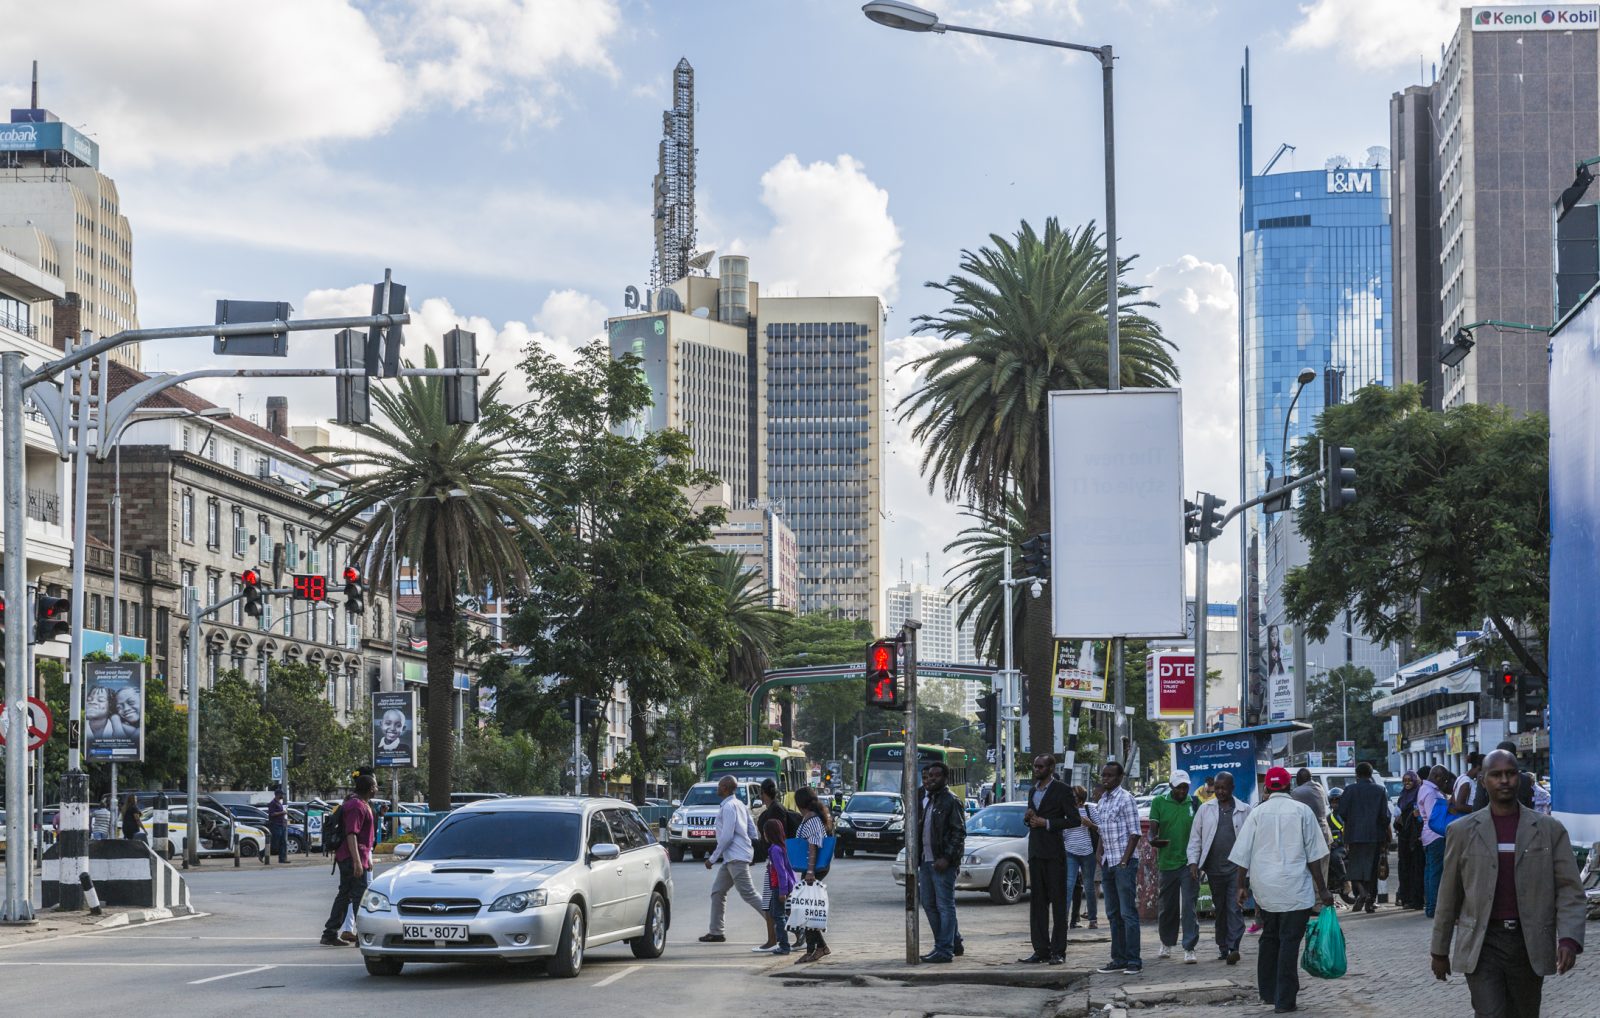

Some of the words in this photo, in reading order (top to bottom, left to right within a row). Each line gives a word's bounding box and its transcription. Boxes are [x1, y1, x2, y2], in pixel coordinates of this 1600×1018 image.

[1493, 11, 1537, 25] Kenol
[1557, 10, 1597, 23] Kobil
[0, 126, 37, 141] cobank
[1327, 172, 1372, 193] I&M
[294, 575, 326, 601] 48
[804, 909, 827, 917] SHOEZ
[404, 927, 428, 938] KBL
[434, 927, 466, 938] 807J
